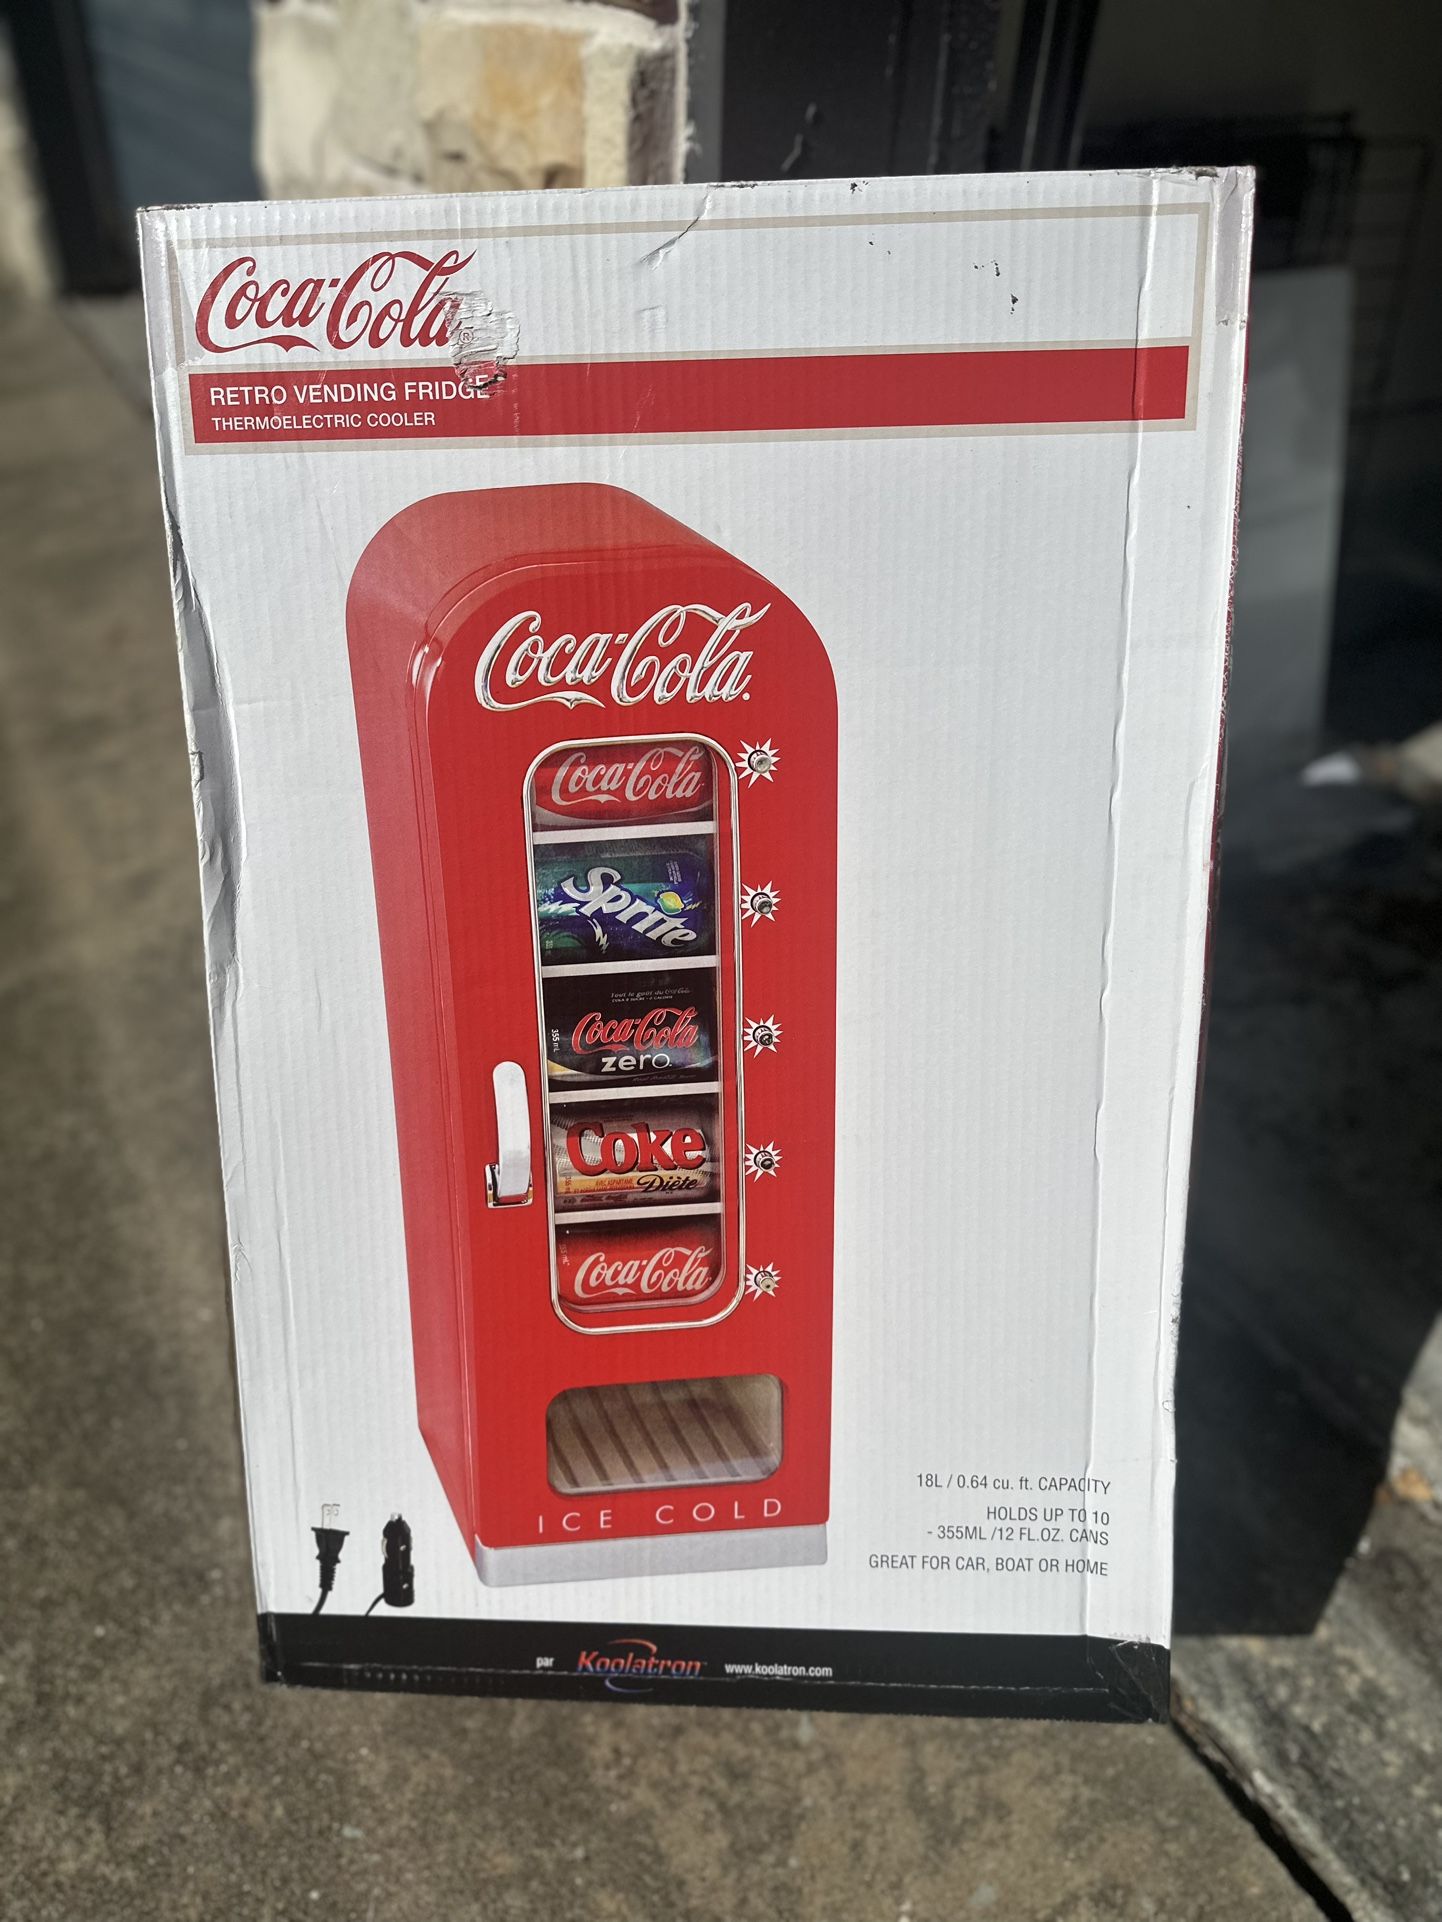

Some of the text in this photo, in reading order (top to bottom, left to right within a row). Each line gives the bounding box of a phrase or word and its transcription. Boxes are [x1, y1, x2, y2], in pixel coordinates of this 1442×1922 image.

[209, 385, 288, 406] RETRO
[292, 382, 397, 404] VENDING
[211, 411, 436, 432] THERMOELECTRIC COOLER
[551, 745, 702, 806] Coca-Cola
[560, 866, 698, 947] Sprite
[571, 1005, 699, 1054] Coca-Cola
[566, 1121, 707, 1177] Coke
[637, 1174, 699, 1193] Diète
[573, 1246, 715, 1298] Coca-Cola
[916, 1473, 1111, 1495] 18L / 0.64 cu. ft. CAPACITY
[538, 1499, 782, 1534] ICE COLD
[986, 1506, 1110, 1526] HOLDS UP TO 10
[936, 1525, 988, 1541] 355ML
[1019, 1527, 1064, 1542] FL.OZ.
[1069, 1528, 1110, 1546] CANS
[868, 1554, 1109, 1577] GREAT FOR CAR, BOAT OR HOME
[536, 1650, 833, 1677] par Koolatron www.koolatron.com
